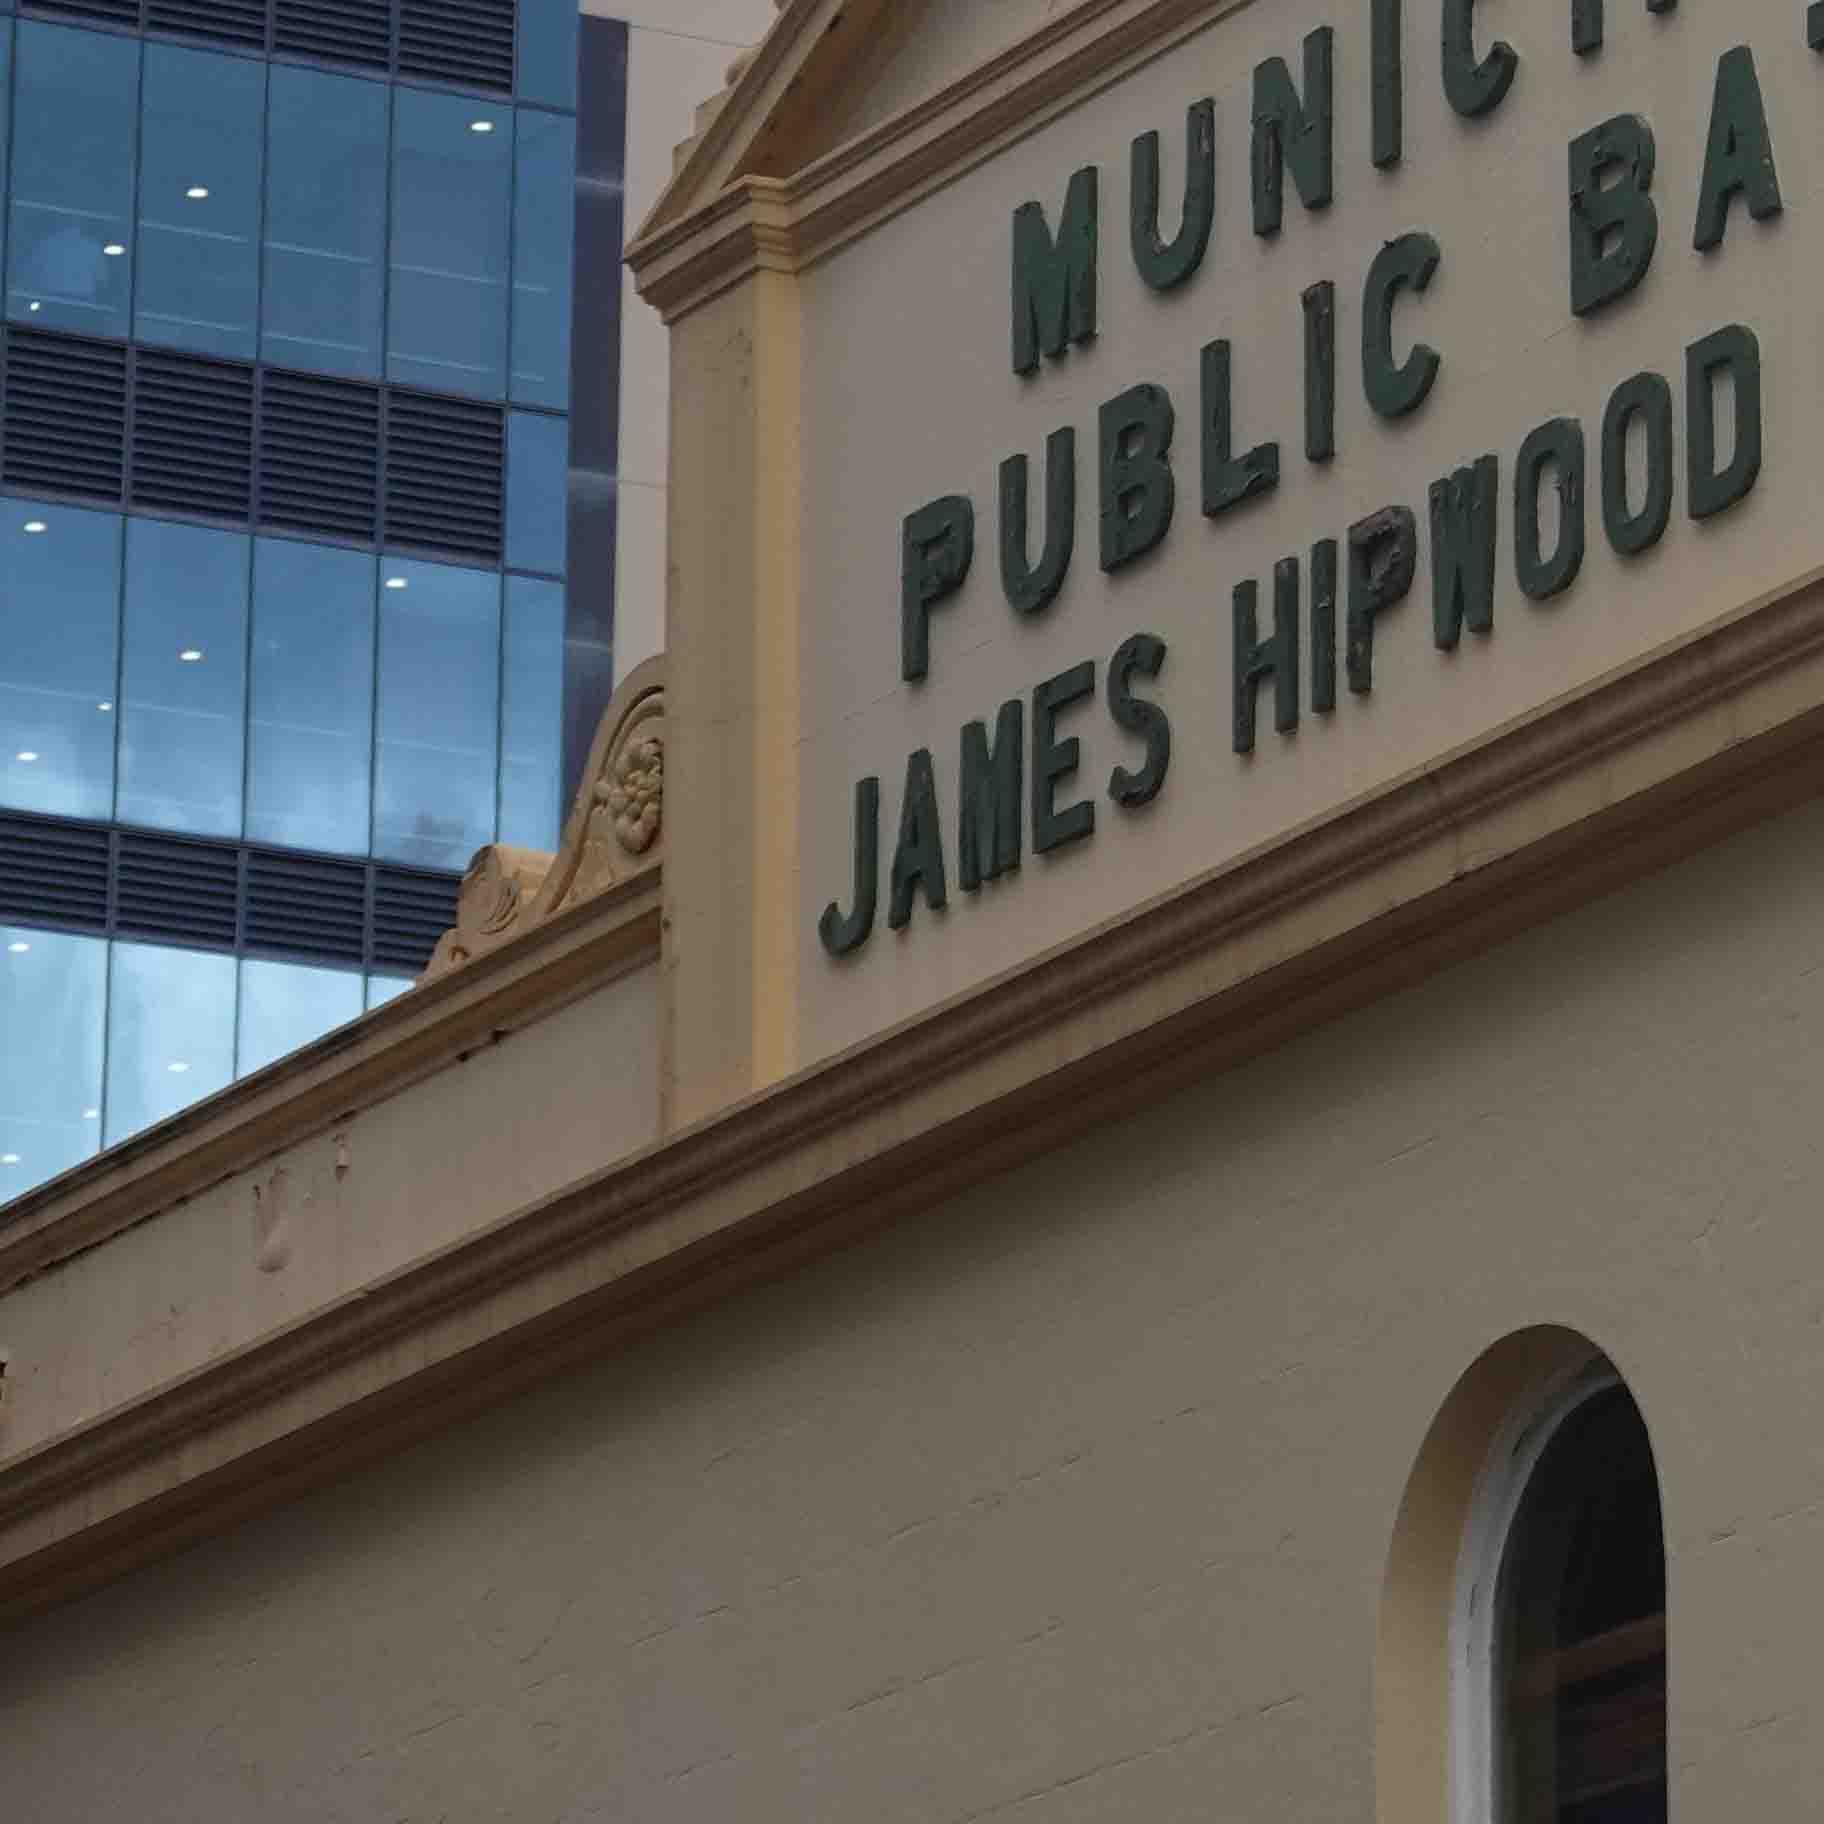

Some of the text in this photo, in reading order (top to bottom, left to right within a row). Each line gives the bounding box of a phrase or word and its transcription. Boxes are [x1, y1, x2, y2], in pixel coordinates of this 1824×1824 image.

[818, 633, 1172, 965] JAMES
[1231, 325, 1762, 761] HIPWOOD
[901, 232, 1441, 689] PUBLIC
